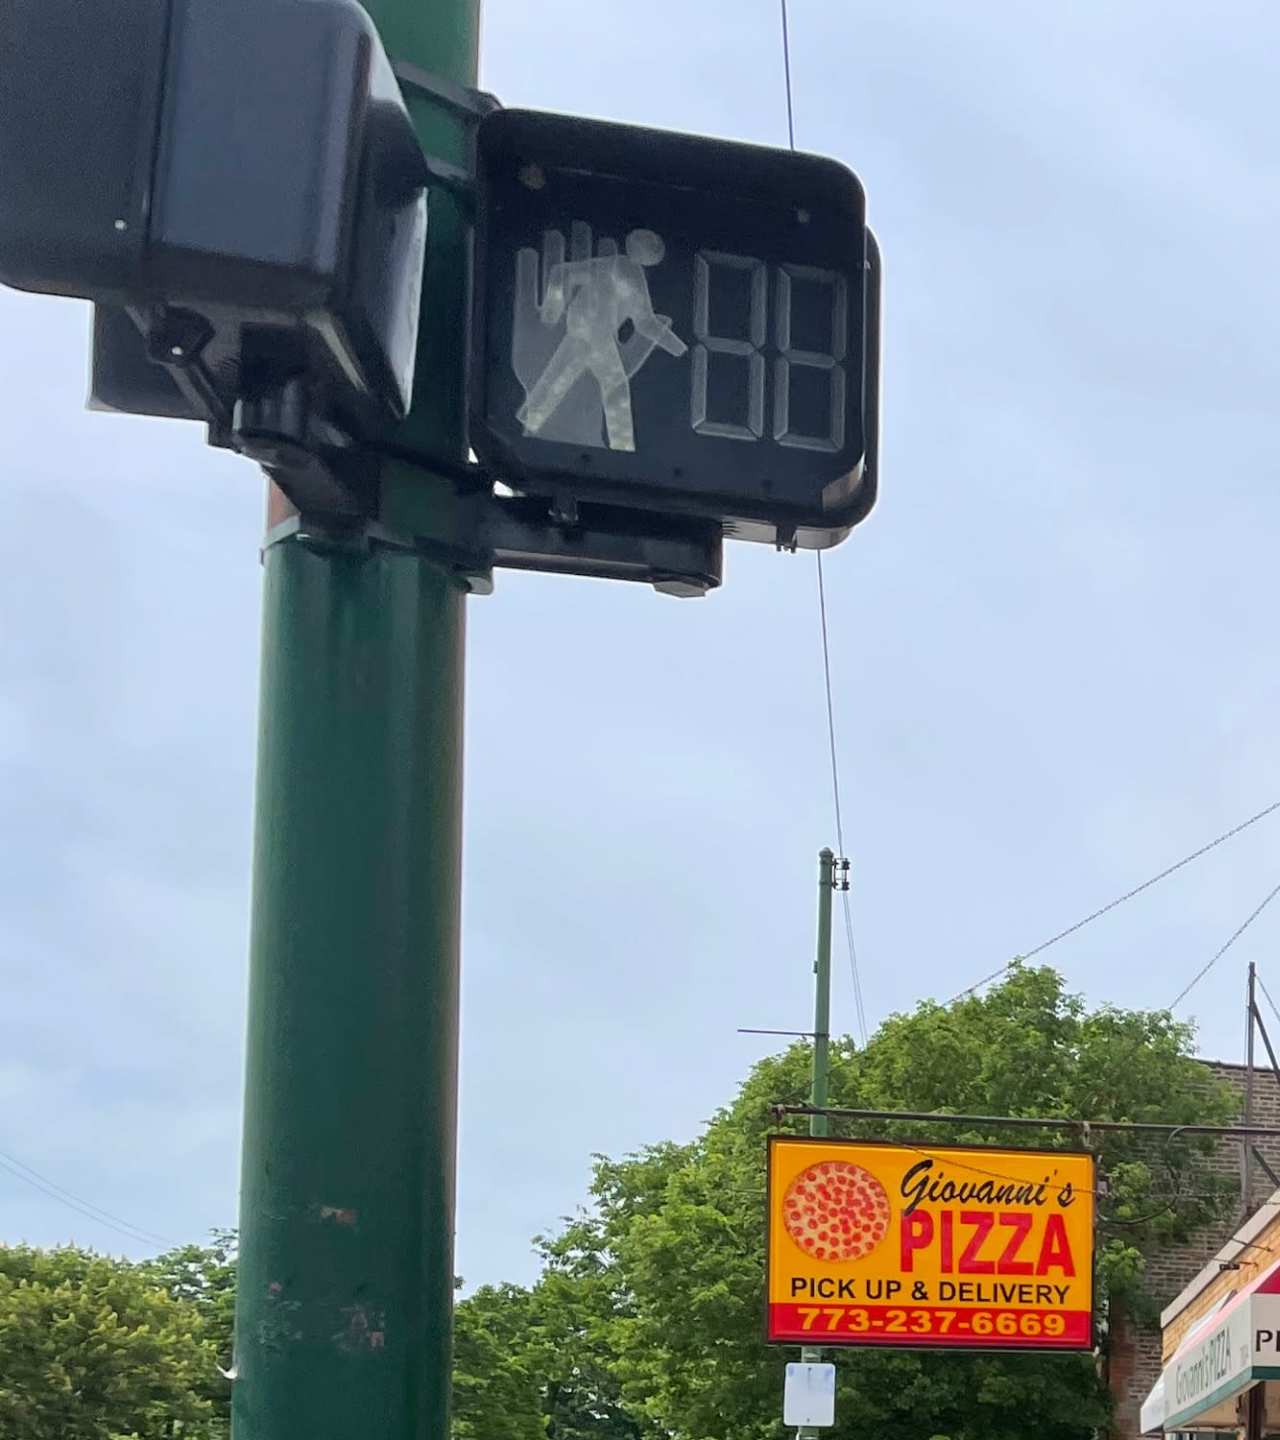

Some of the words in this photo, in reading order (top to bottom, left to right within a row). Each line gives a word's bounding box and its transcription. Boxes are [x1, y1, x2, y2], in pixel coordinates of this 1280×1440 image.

[901, 1158, 1076, 1217] Giovanni's
[900, 1209, 1076, 1277] PIZZA
[790, 1277, 855, 1300] PICK
[866, 1279, 902, 1301] UP
[910, 1281, 929, 1302] &
[938, 1282, 1070, 1306] DELIVERY
[797, 1306, 1066, 1338] 773-237-6669
[1210, 1327, 1233, 1380] PIZZA
